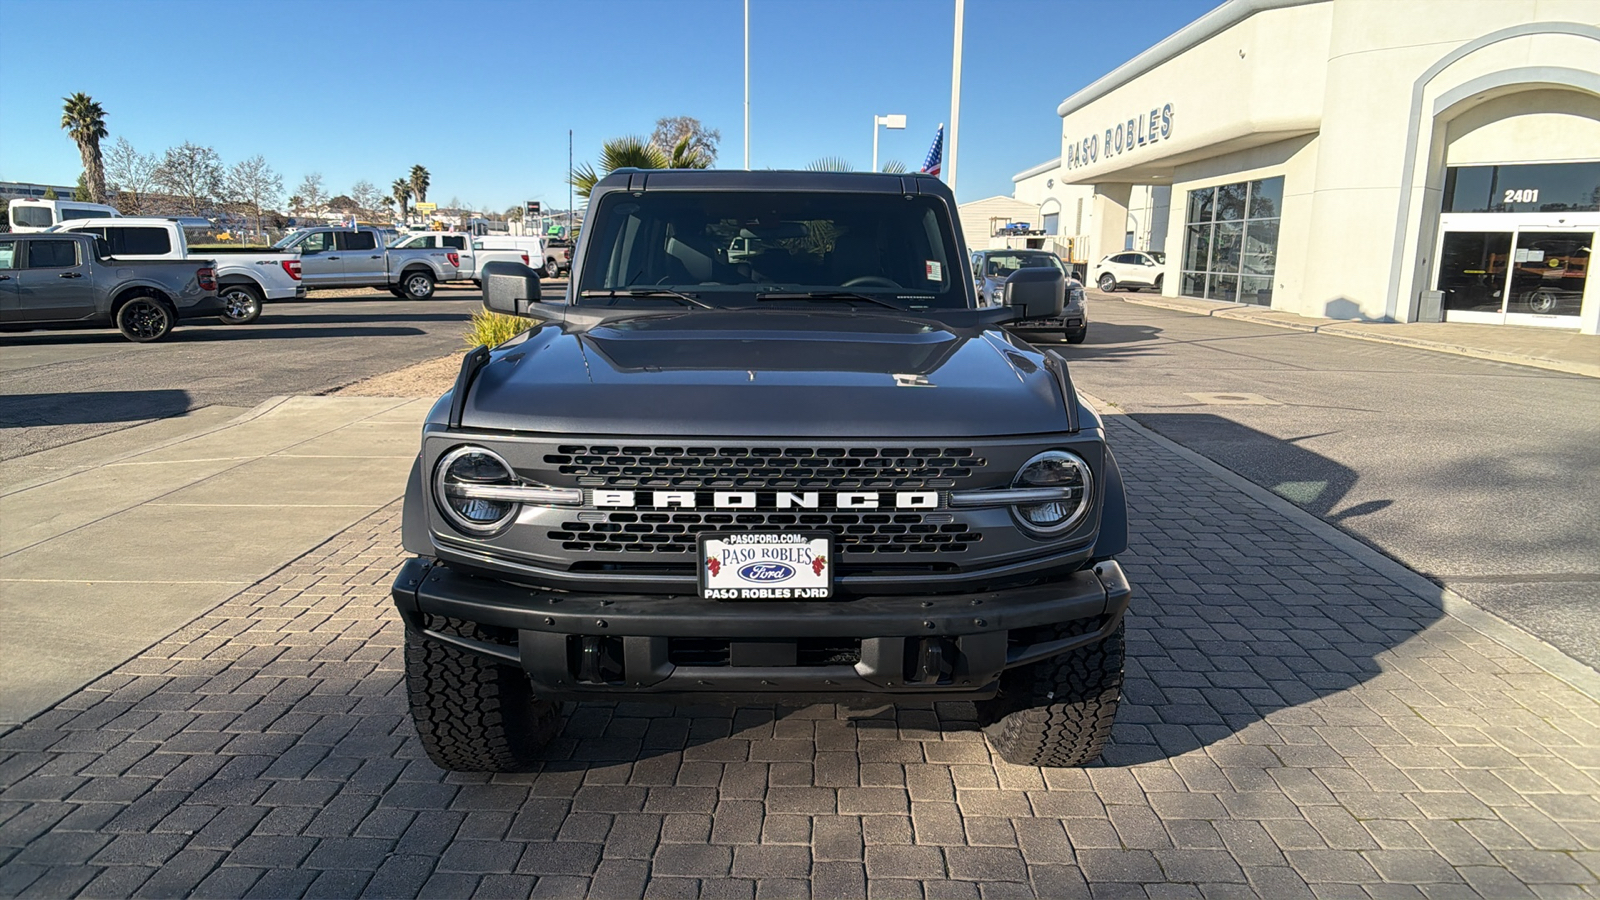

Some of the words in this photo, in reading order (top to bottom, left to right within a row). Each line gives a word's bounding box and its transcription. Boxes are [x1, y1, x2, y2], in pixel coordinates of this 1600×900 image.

[1068, 134, 1098, 169] PASO
[1104, 103, 1173, 158] ROBLES
[1503, 189, 1539, 203] 2401
[592, 490, 938, 509] BRONCO
[730, 534, 802, 545] PASOFORD.COM
[722, 548, 756, 566] PASO
[761, 547, 812, 565] ROBLES
[749, 564, 785, 580] Ford
[704, 588, 738, 599] PASO
[741, 588, 791, 598] ROBLES
[794, 588, 829, 598] FORD
